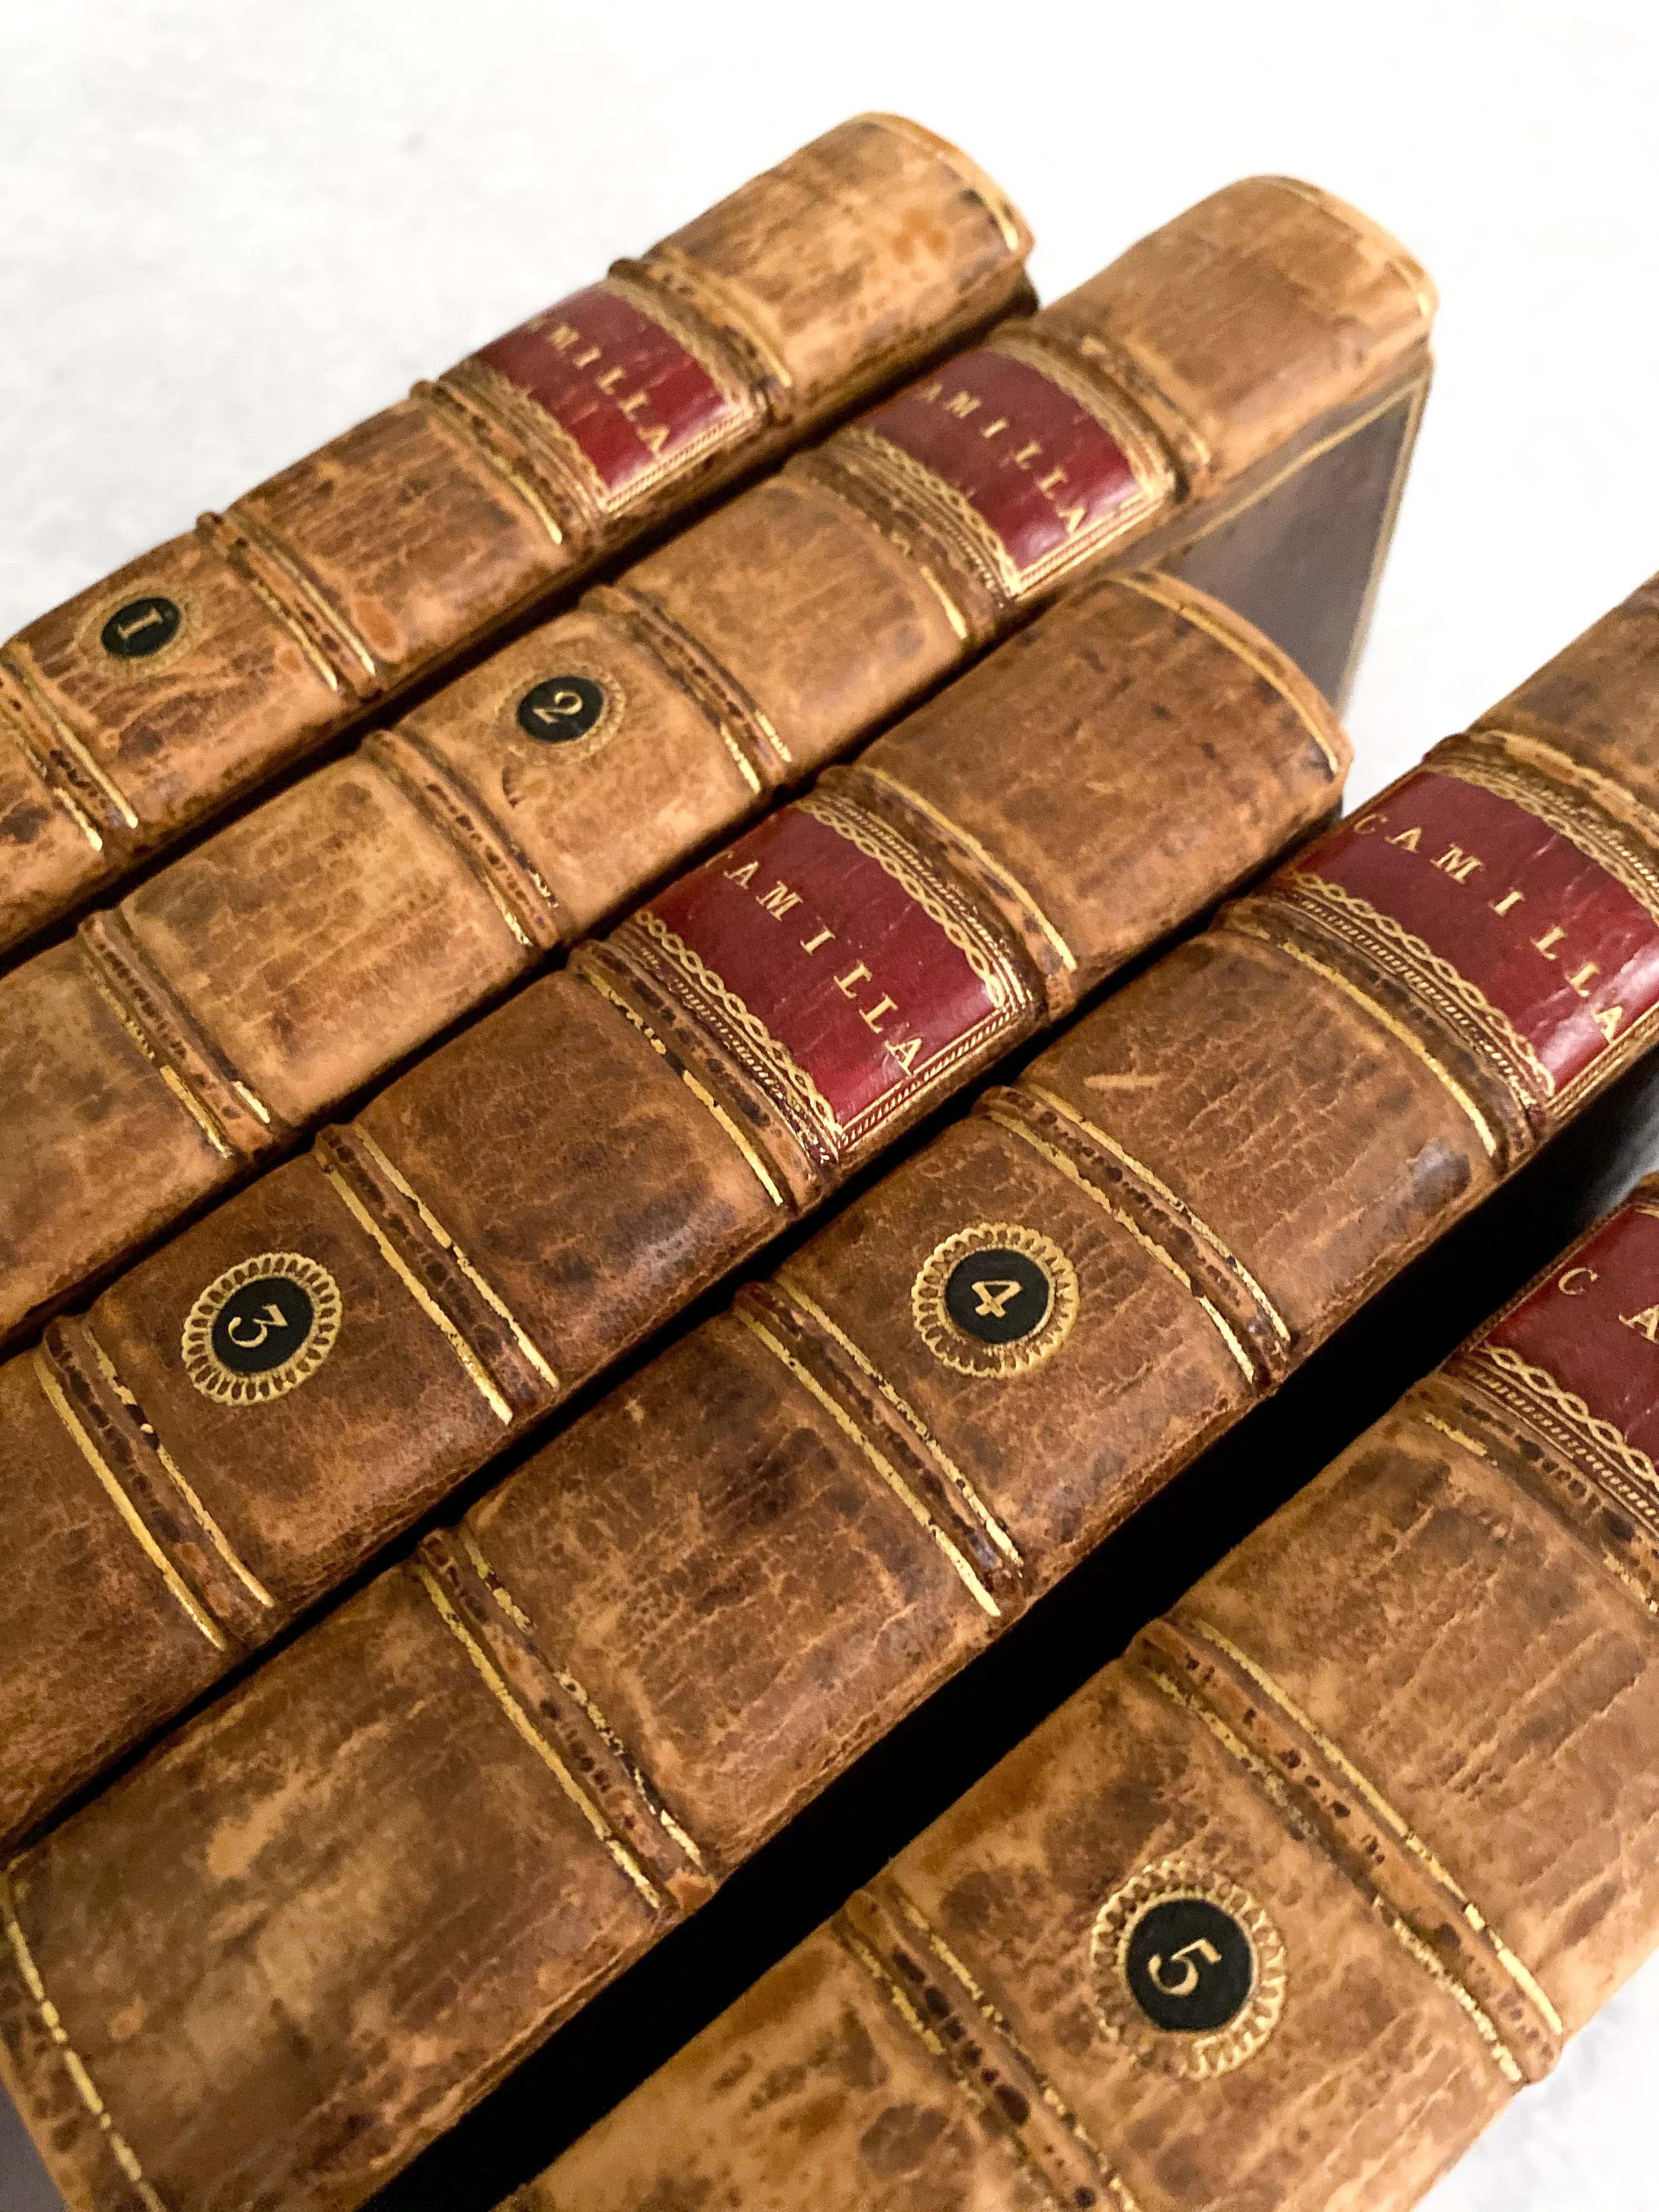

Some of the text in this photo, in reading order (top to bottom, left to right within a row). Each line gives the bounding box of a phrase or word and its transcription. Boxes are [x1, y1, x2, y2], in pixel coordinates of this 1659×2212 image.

[117, 607, 163, 640] 1
[532, 690, 583, 724] 2
[1354, 814, 1623, 1043] CAMILLA
[972, 1280, 1022, 1318] 4
[228, 1304, 289, 1348] 3
[1148, 1938, 1222, 1996] 5
